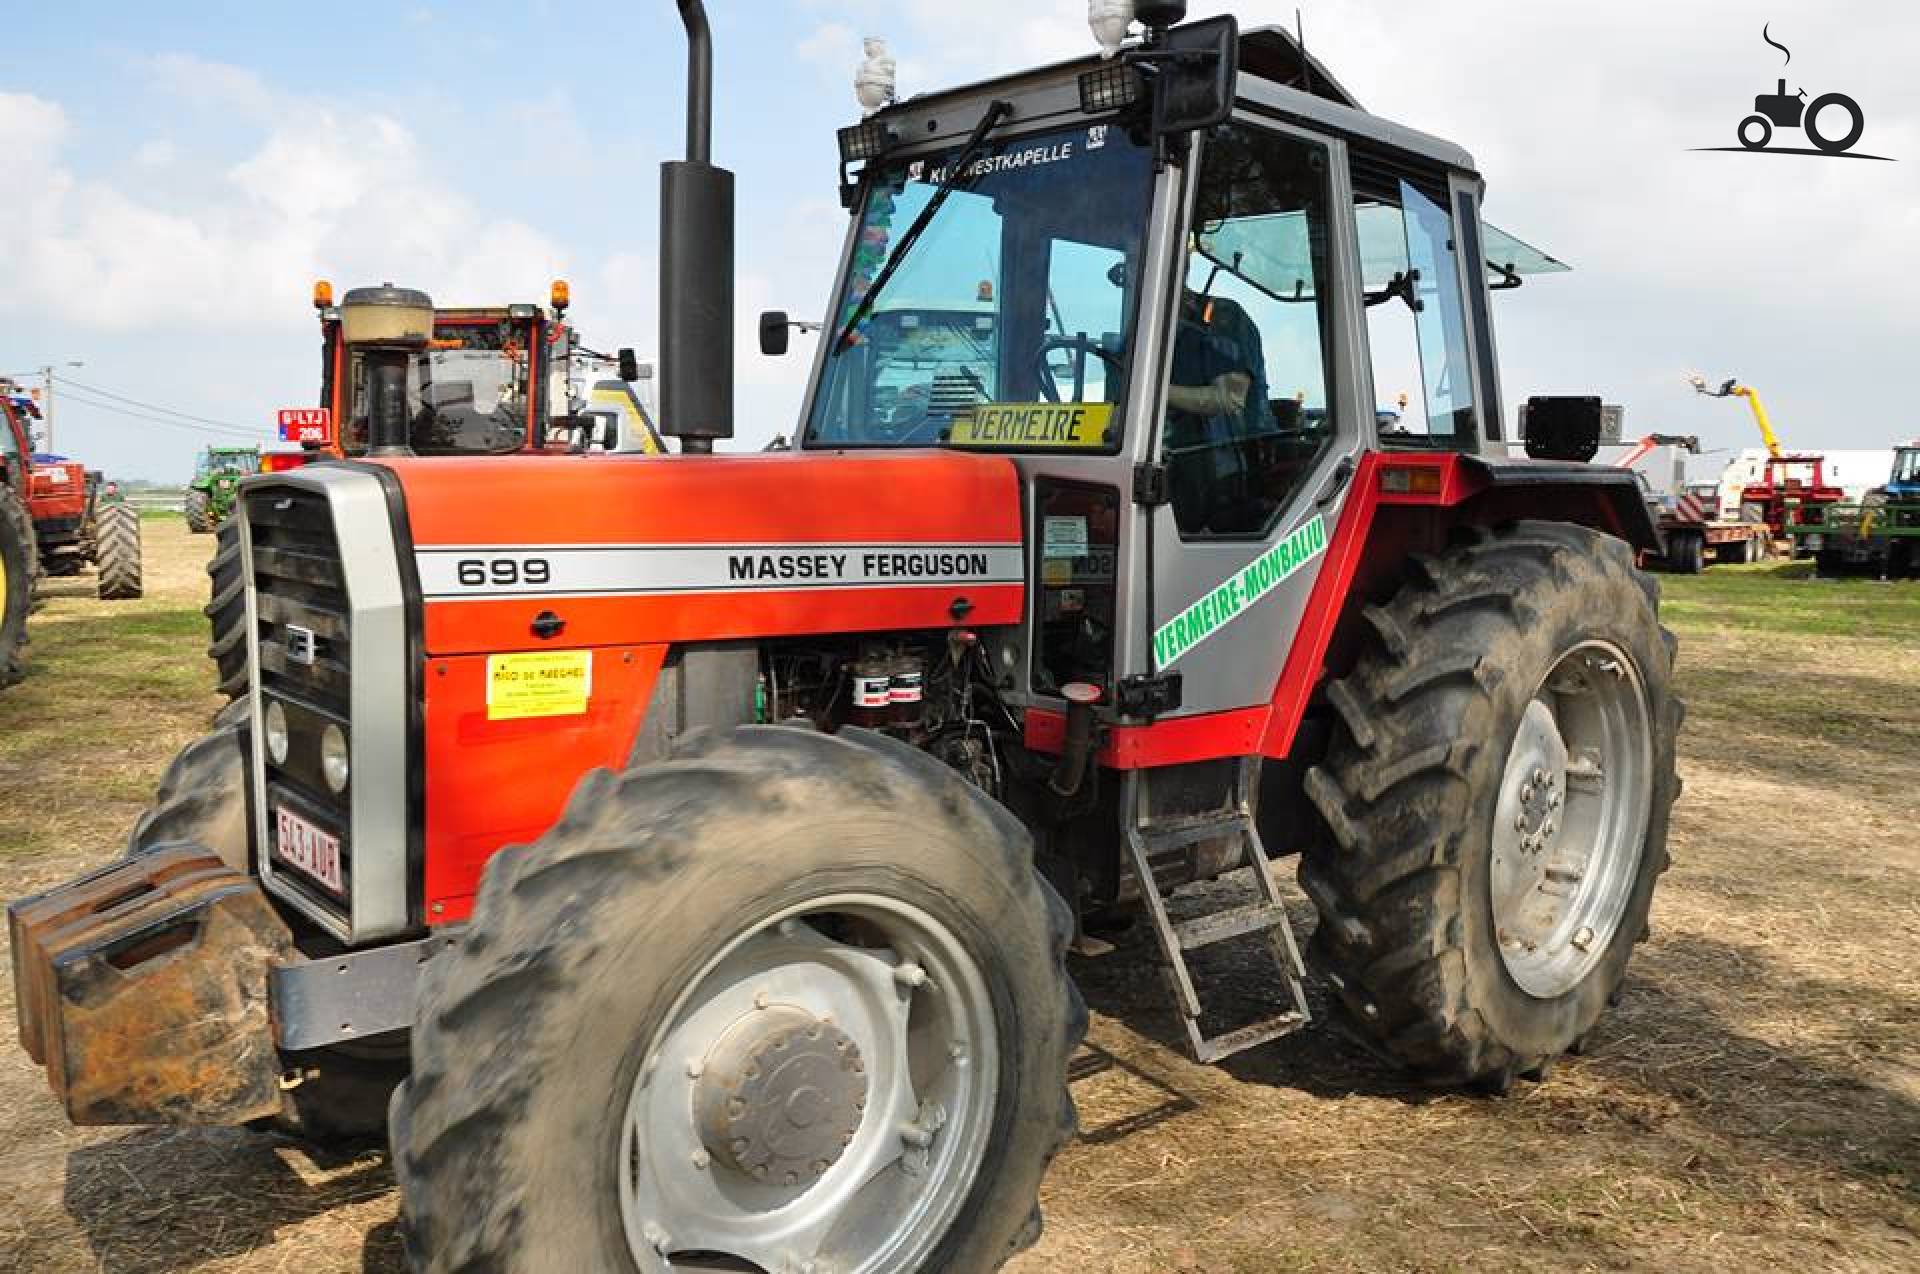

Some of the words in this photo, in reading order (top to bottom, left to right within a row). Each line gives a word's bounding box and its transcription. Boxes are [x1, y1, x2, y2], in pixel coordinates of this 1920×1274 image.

[971, 409, 1086, 441] VERMEIRE
[458, 559, 550, 585] 699
[729, 554, 847, 579] MASSEY
[863, 553, 988, 577] FERGUSON
[1154, 516, 1323, 666] VERMEIRE-MONBALIU
